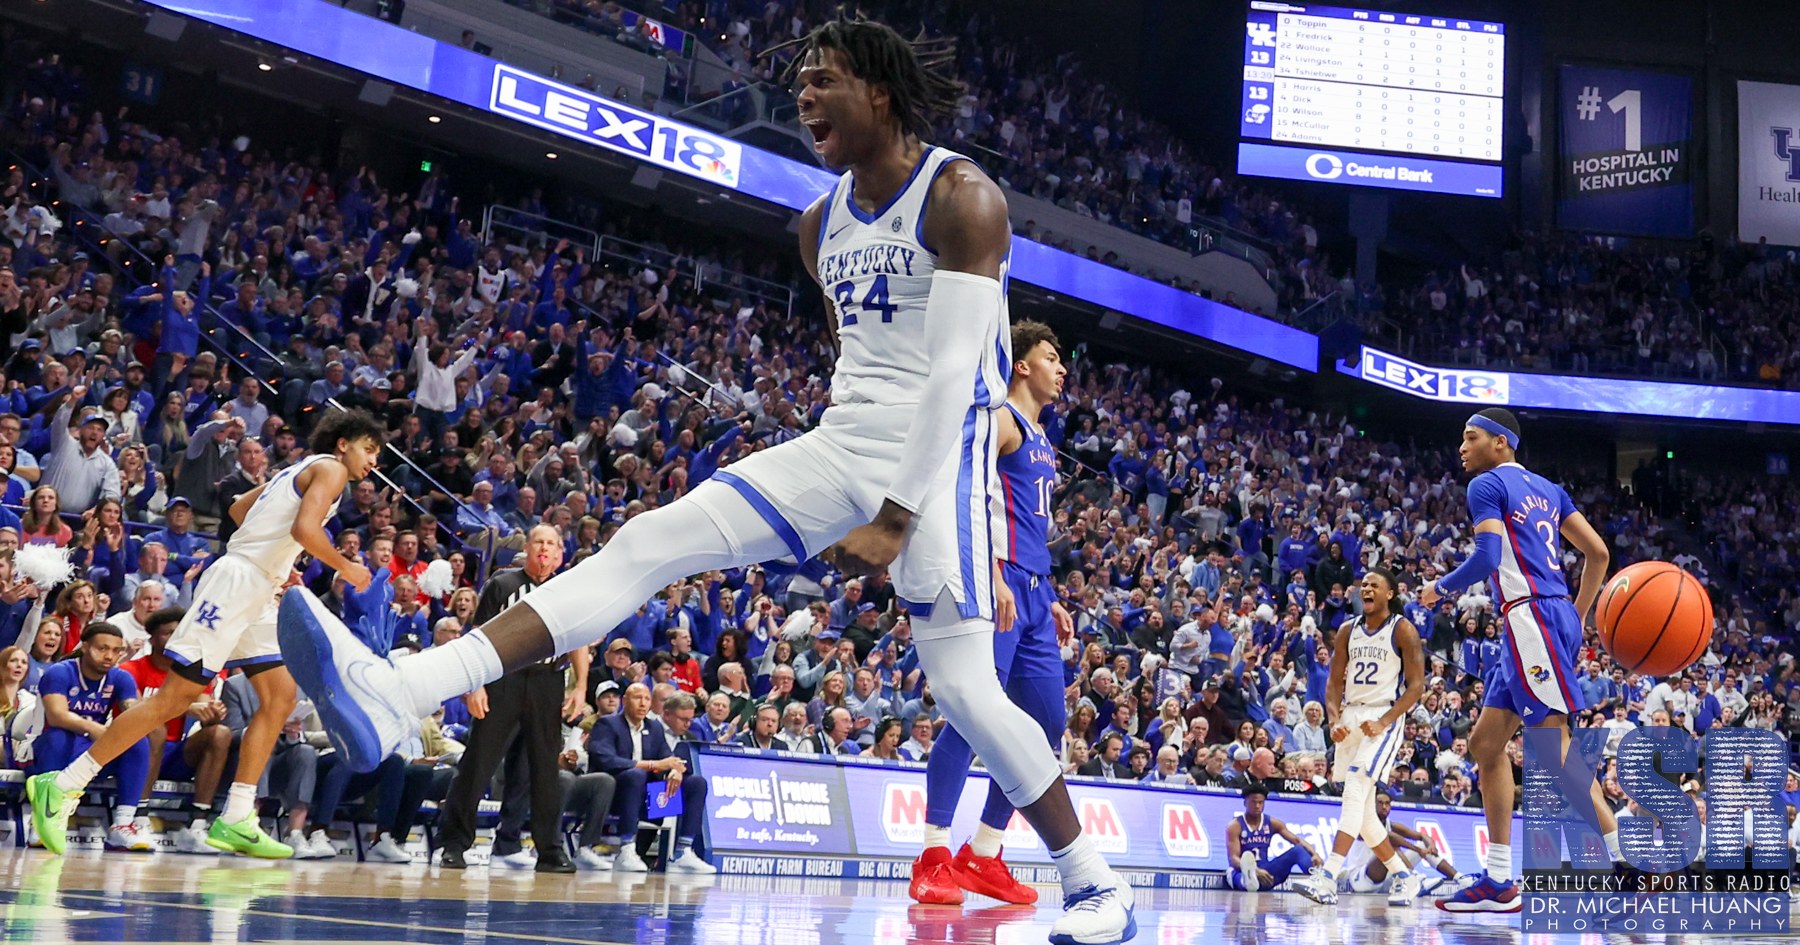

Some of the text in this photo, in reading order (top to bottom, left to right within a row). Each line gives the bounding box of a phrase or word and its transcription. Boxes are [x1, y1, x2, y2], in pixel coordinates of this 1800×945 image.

[1298, 19, 1327, 28] Toppin
[1296, 31, 1332, 41] Fredrick
[1296, 43, 1330, 52] Wallace
[1251, 51, 1270, 64] 13
[1295, 56, 1342, 66] Livingston
[1295, 68, 1337, 78] Tshiebwe
[127, 71, 154, 96] 31
[1294, 83, 1321, 92] Harris
[1249, 86, 1268, 100] 13
[1293, 108, 1323, 116] Wilson
[1577, 86, 1641, 151] #1
[1292, 121, 1330, 130] McCullar
[1291, 133, 1322, 141] Adams
[1572, 149, 1679, 174] HOSPITAL IN
[1346, 162, 1433, 183] Central Bank
[1580, 167, 1673, 191] KENTUCKY
[835, 274, 897, 328] 24
[1029, 449, 1056, 470] KANSA
[1034, 476, 1054, 517] 10
[1537, 520, 1561, 571] 3
[1350, 646, 1388, 662] KENTUCKY
[1354, 662, 1378, 685] 22
[1164, 673, 1180, 695] 3
[712, 776, 772, 800] BUCKLE
[780, 780, 830, 804] PHONE
[1284, 780, 1305, 792] POSS
[752, 801, 774, 822] UP
[784, 803, 831, 825] DOWN
[1085, 803, 1120, 836] M
[891, 827, 924, 837] Marat
[1169, 809, 1201, 841] M
[737, 827, 819, 846] Be safe, Kentucky.
[1005, 834, 1035, 843] arathon
[1094, 840, 1123, 848] arathon
[722, 857, 843, 876] KENTUCKY FARM BUREAU
[859, 861, 875, 877] BIG
[877, 863, 890, 878] ON
[1012, 868, 1062, 882] FARM BUREA
[1121, 872, 1156, 886] MITMENT
[1169, 874, 1204, 888] KENTUCKY
